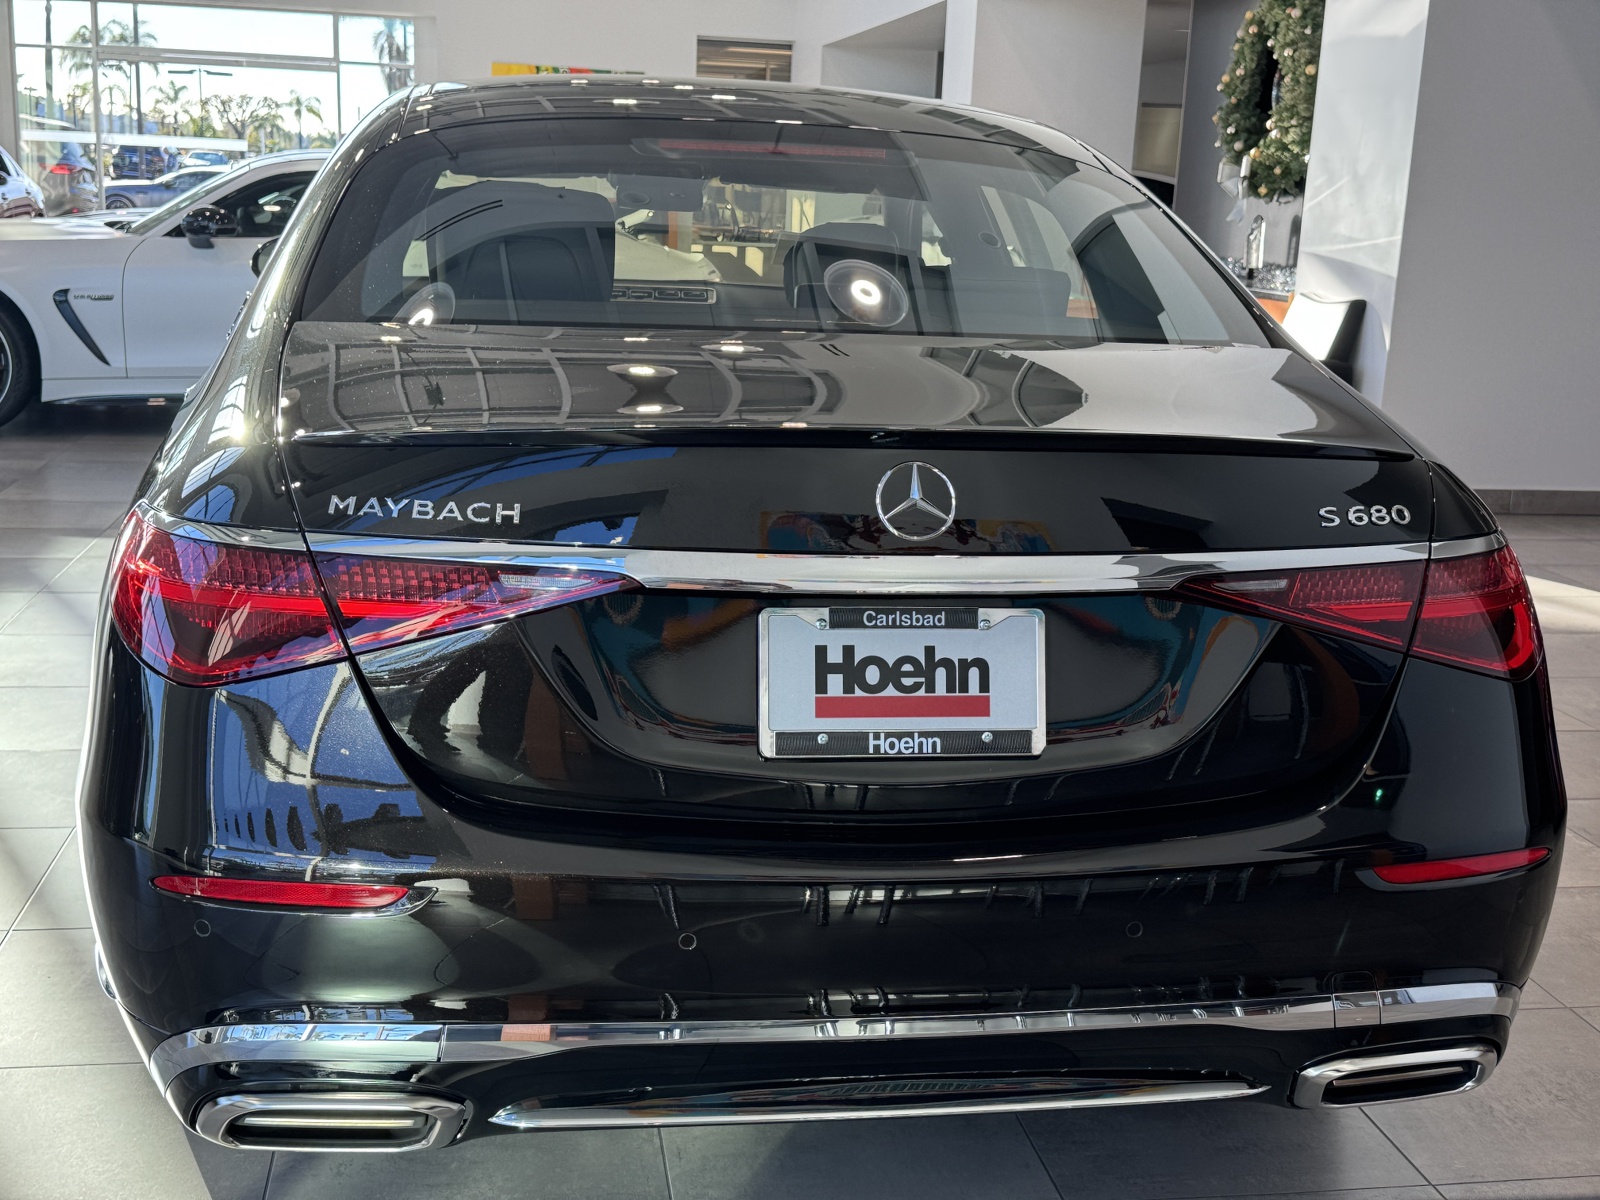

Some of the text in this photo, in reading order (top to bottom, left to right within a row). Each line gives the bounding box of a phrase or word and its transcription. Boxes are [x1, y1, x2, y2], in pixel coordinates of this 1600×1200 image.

[327, 494, 521, 525] MAYBACH
[1318, 504, 1411, 527] S 680
[862, 610, 946, 627] Carlsbad
[814, 644, 990, 695] Hoehn
[868, 732, 941, 754] Hoehn
